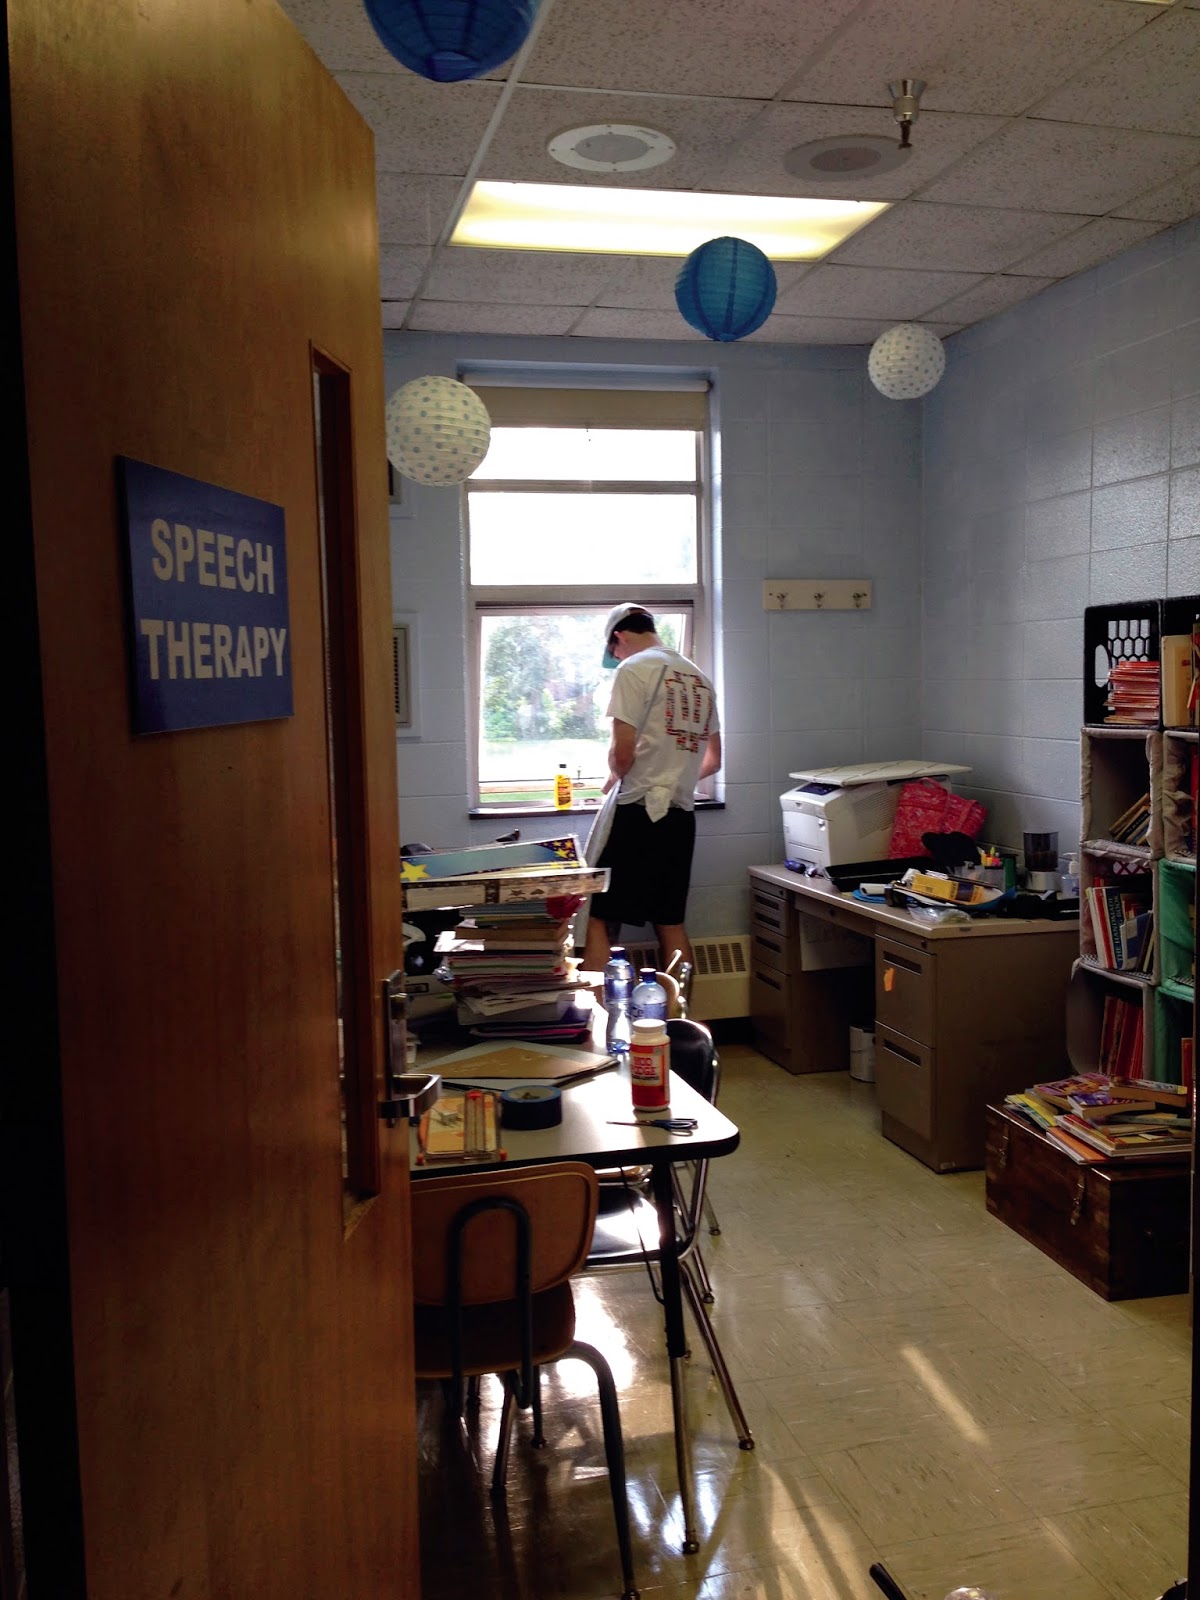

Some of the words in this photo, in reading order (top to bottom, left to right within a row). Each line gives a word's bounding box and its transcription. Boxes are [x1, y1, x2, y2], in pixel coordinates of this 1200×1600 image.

[151, 518, 275, 595] SPEECH
[140, 618, 287, 680] THERAPY
[1113, 894, 1122, 917] BOOK
[1114, 945, 1123, 961] THE
